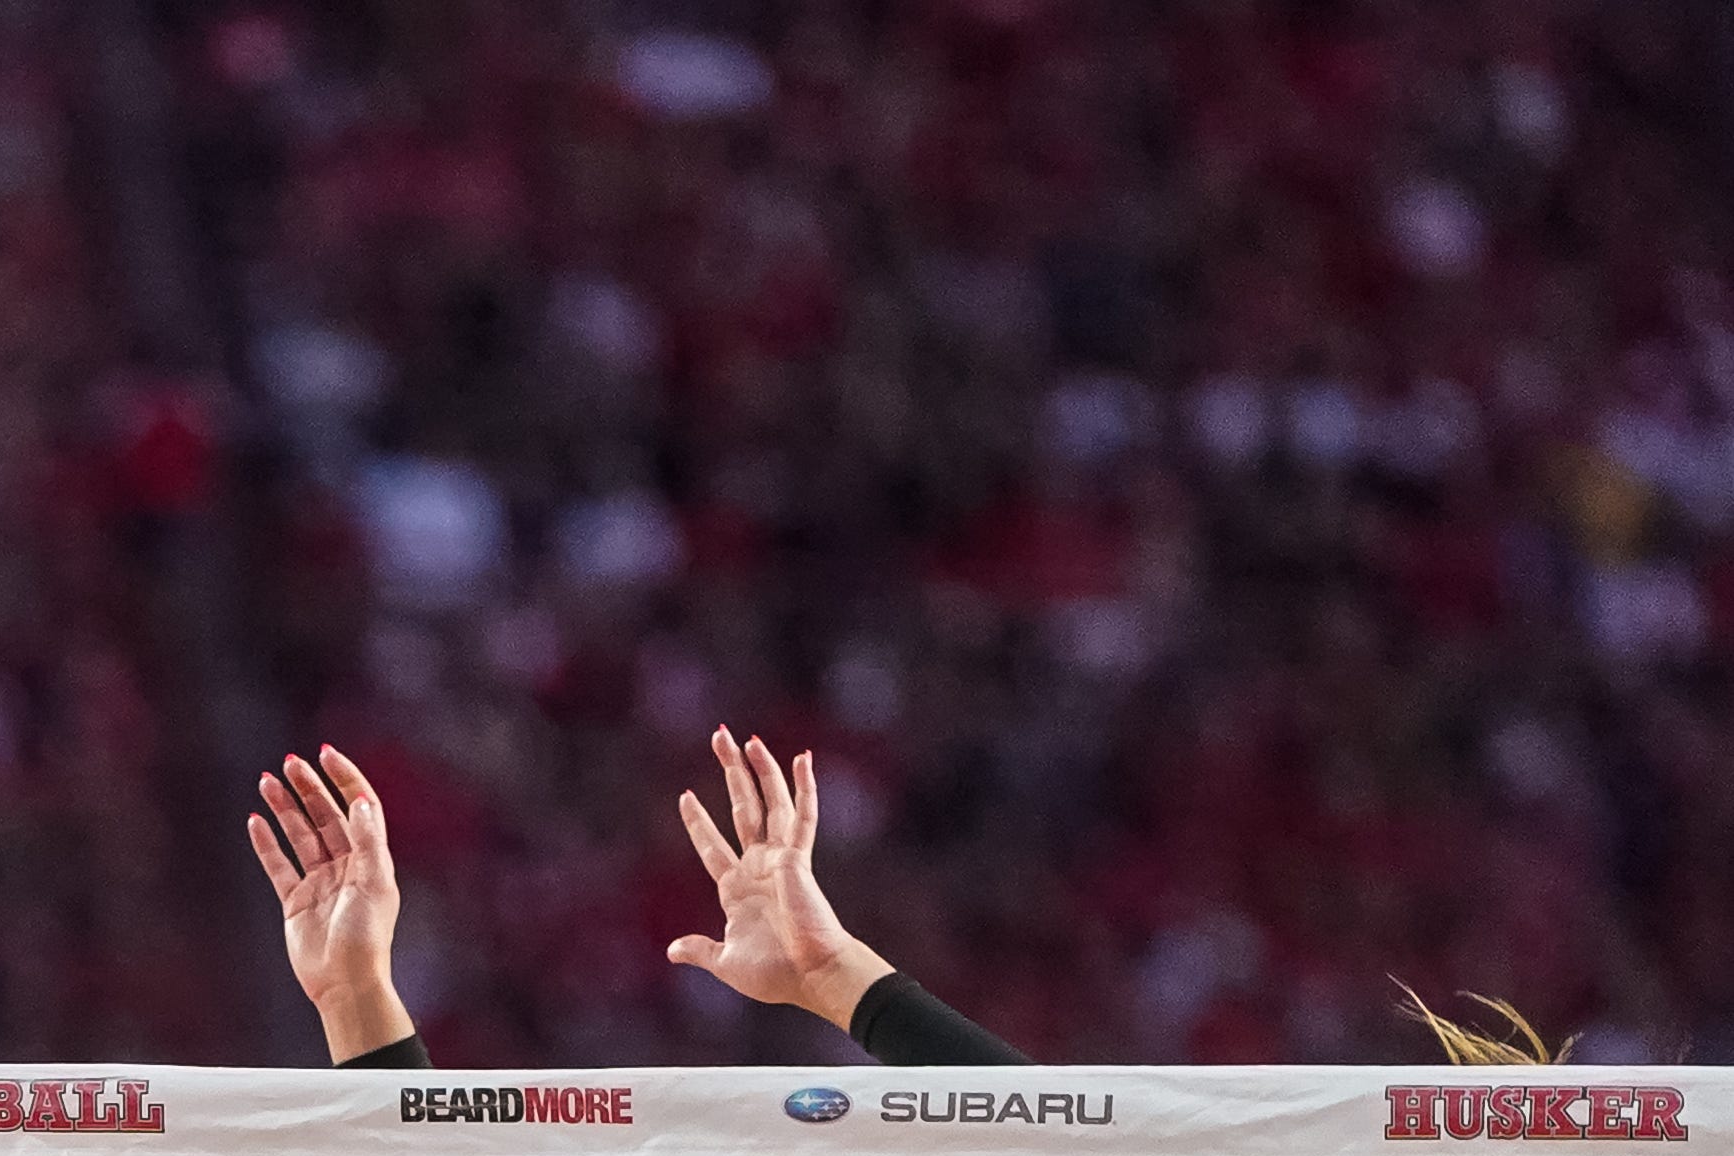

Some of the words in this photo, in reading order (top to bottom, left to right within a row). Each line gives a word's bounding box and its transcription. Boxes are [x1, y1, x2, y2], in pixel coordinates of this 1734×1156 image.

[400, 1087, 633, 1125] BEARDMORE
[879, 1091, 1114, 1126] SUBARU
[1384, 1085, 1689, 1142] HUSKER
